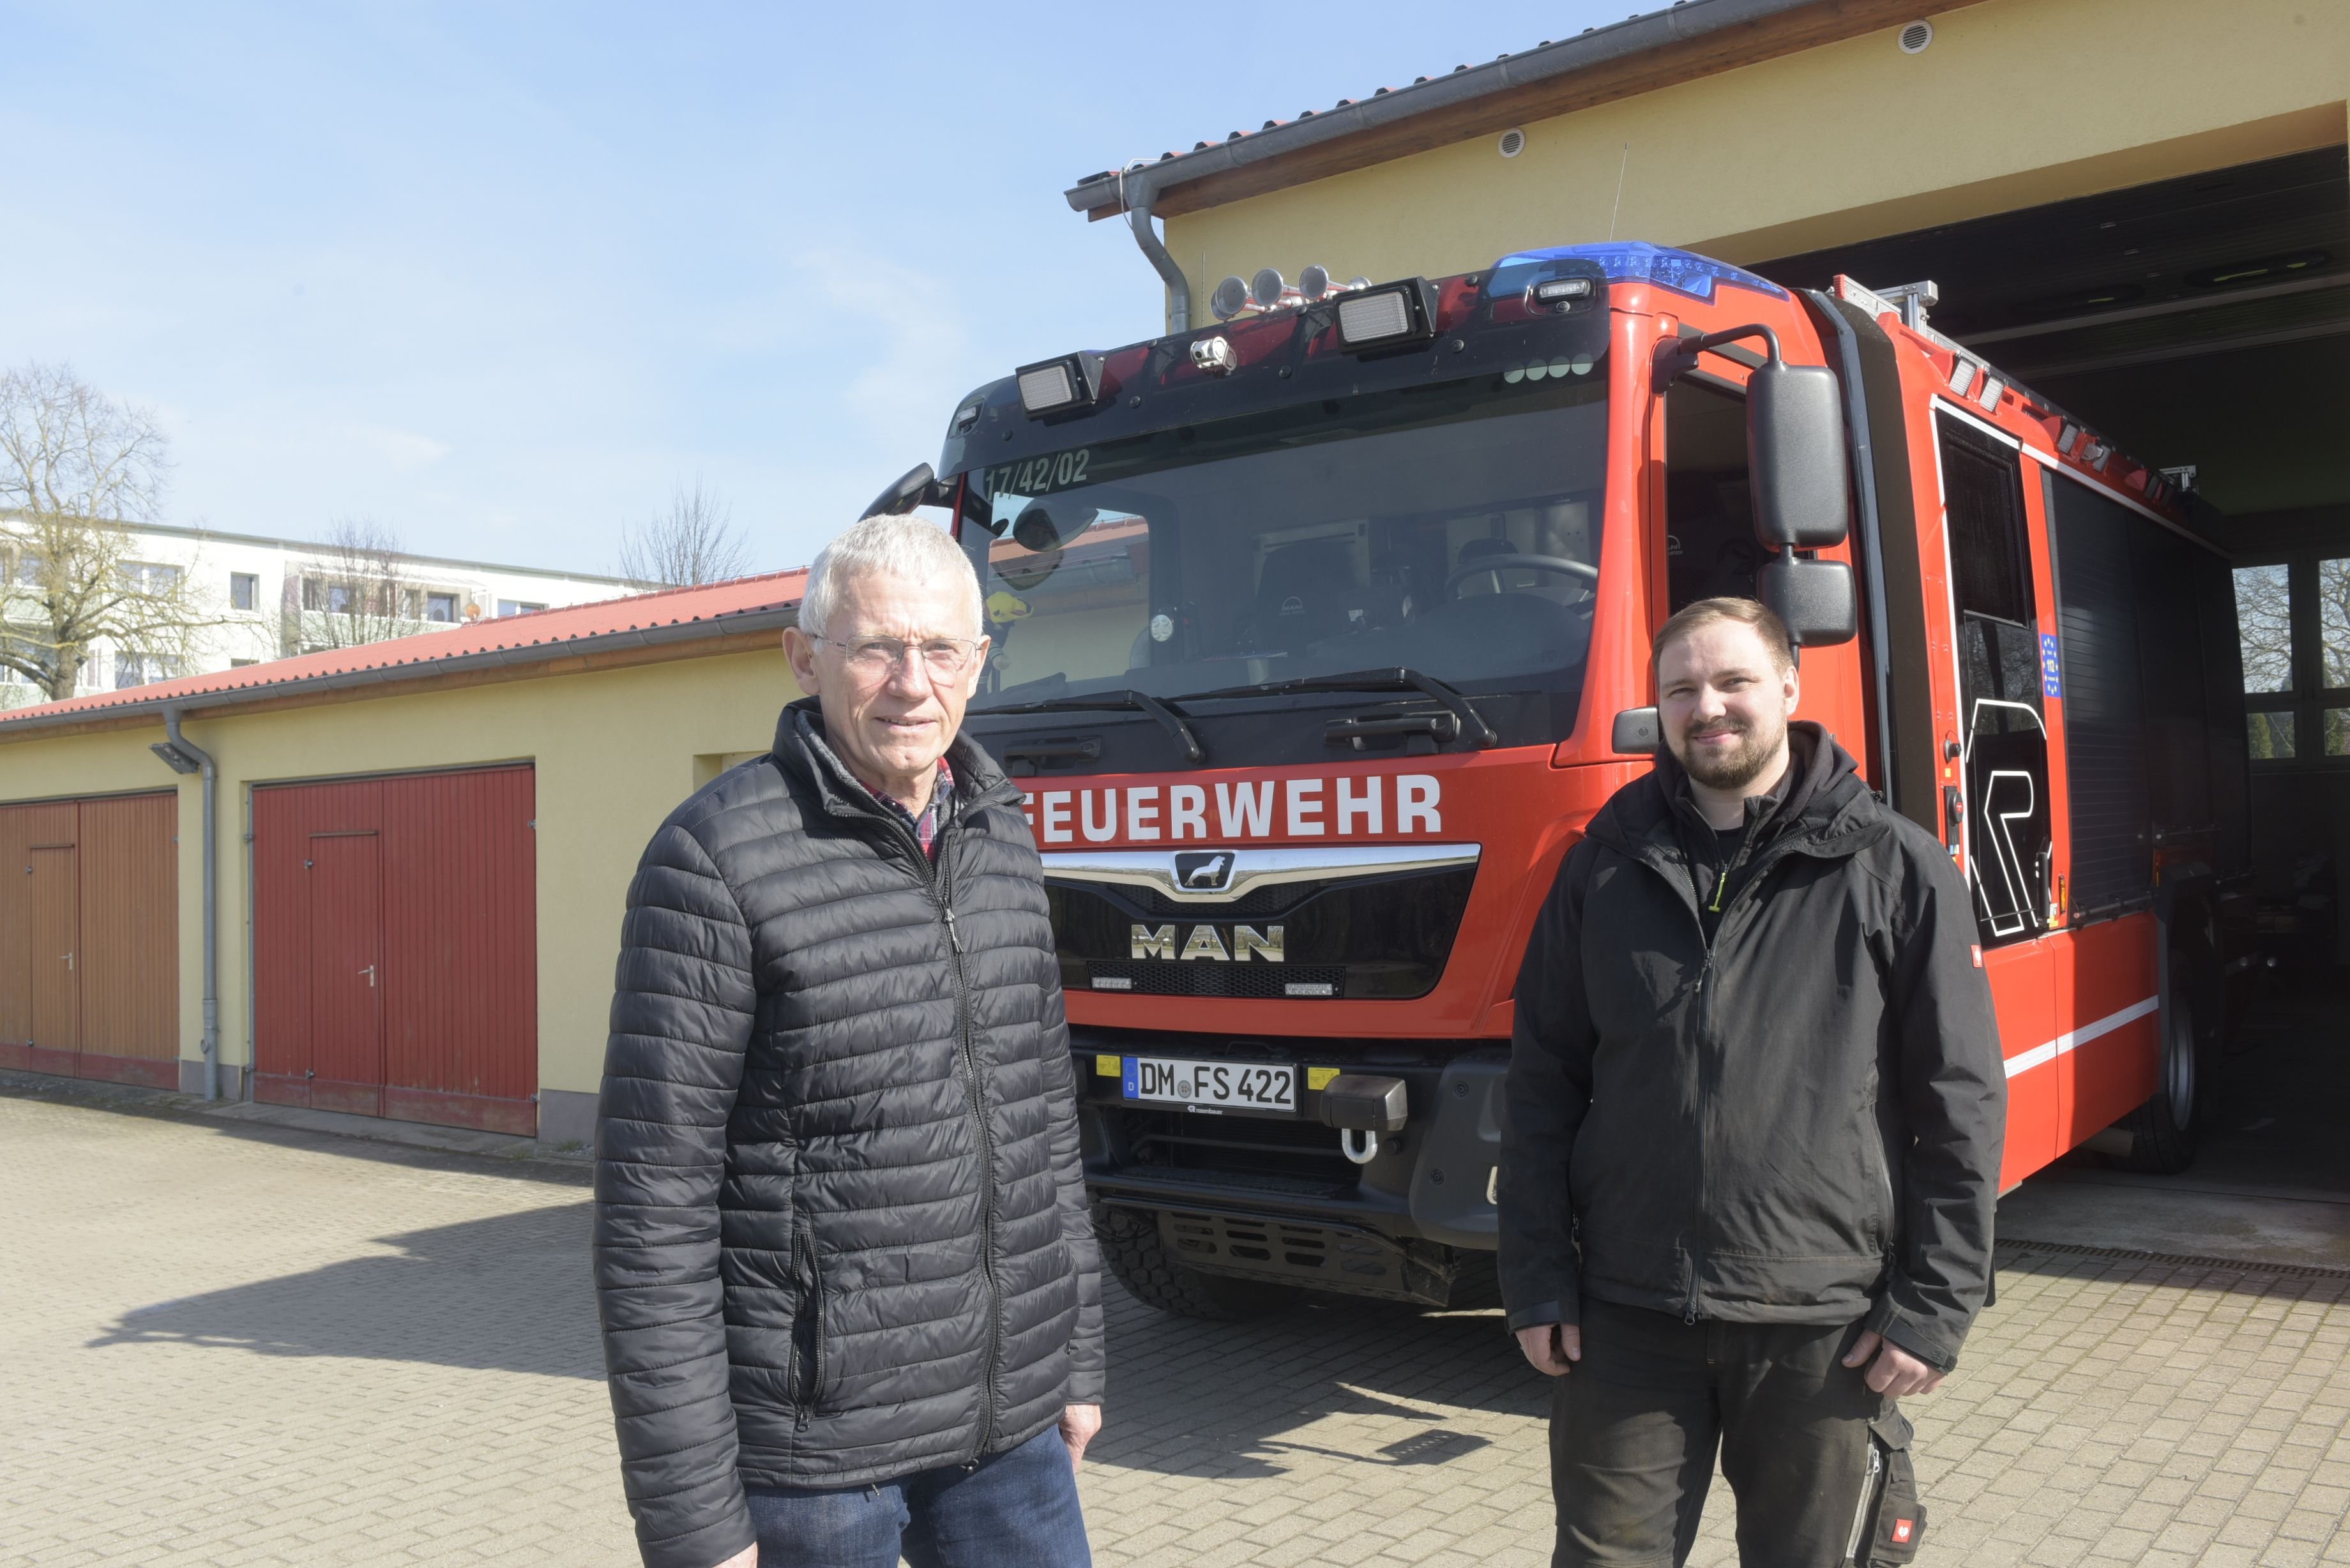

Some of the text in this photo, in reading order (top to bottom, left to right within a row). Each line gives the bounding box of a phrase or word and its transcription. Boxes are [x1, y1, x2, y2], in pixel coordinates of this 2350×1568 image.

[985, 449, 1089, 501] 17/42/02
[2046, 658, 2055, 673] 112
[1022, 774, 1441, 843] EUERWEHR
[1131, 923, 1285, 963] MAN
[1128, 1082, 1135, 1092] D
[1140, 1062, 1175, 1096] DM
[1194, 1066, 1230, 1100] FS
[1238, 1069, 1291, 1104] 422
